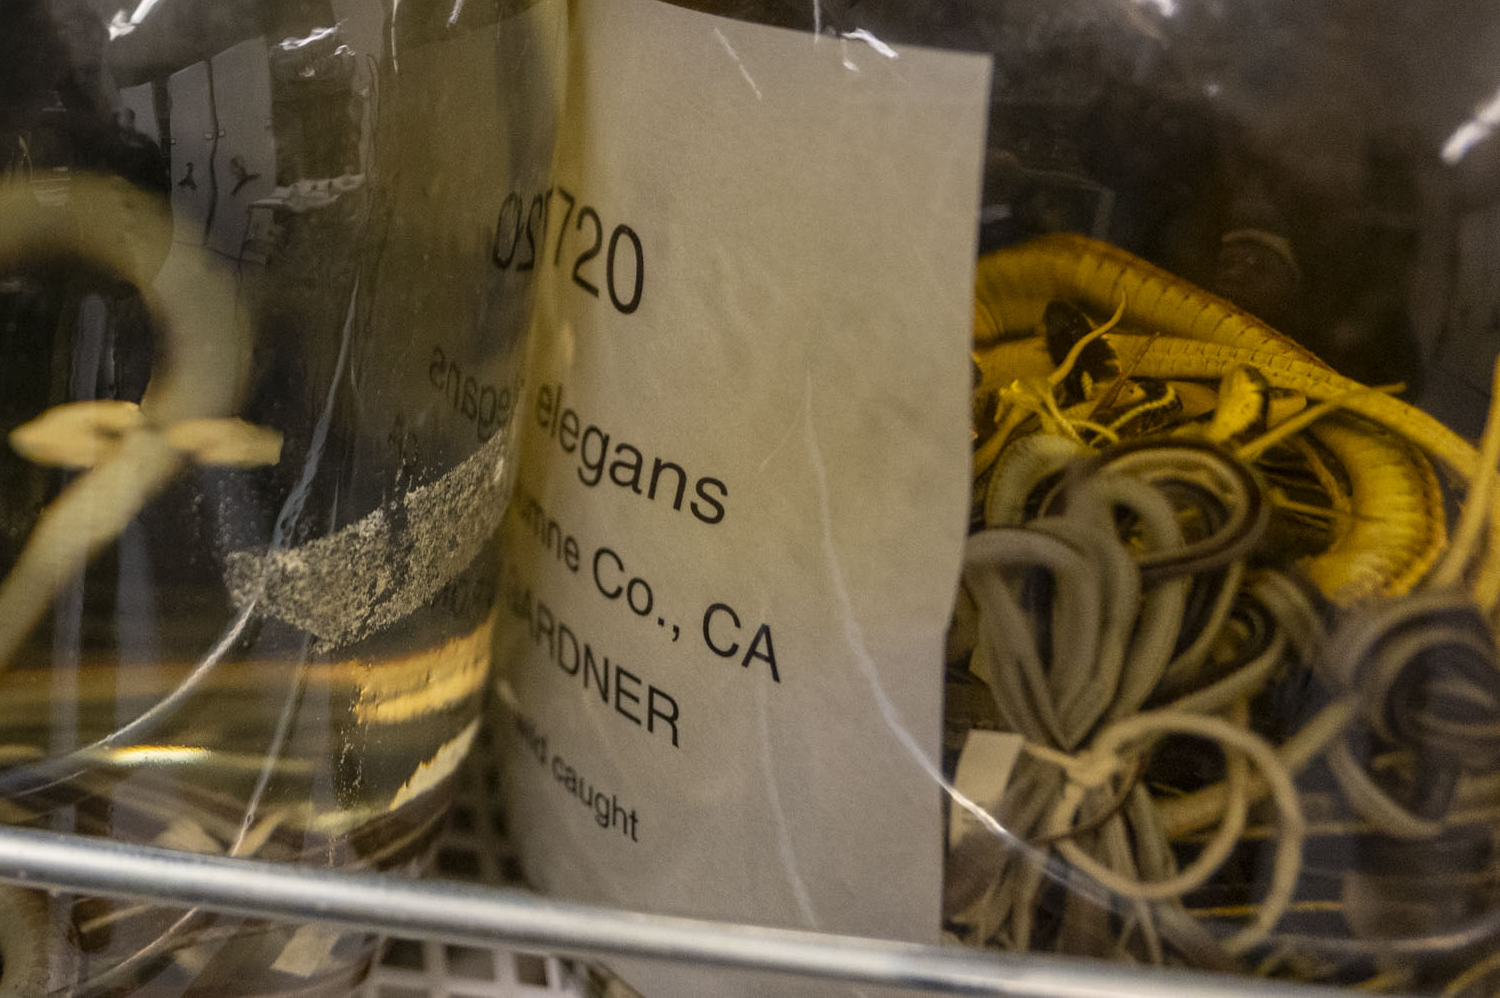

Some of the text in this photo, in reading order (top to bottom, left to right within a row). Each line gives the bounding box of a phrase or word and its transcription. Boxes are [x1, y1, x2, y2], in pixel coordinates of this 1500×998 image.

[552, 186, 645, 315] 720
[535, 381, 729, 525] elegans
[592, 546, 681, 642] Co.,
[702, 602, 781, 684] CA
[551, 755, 639, 843] caught
